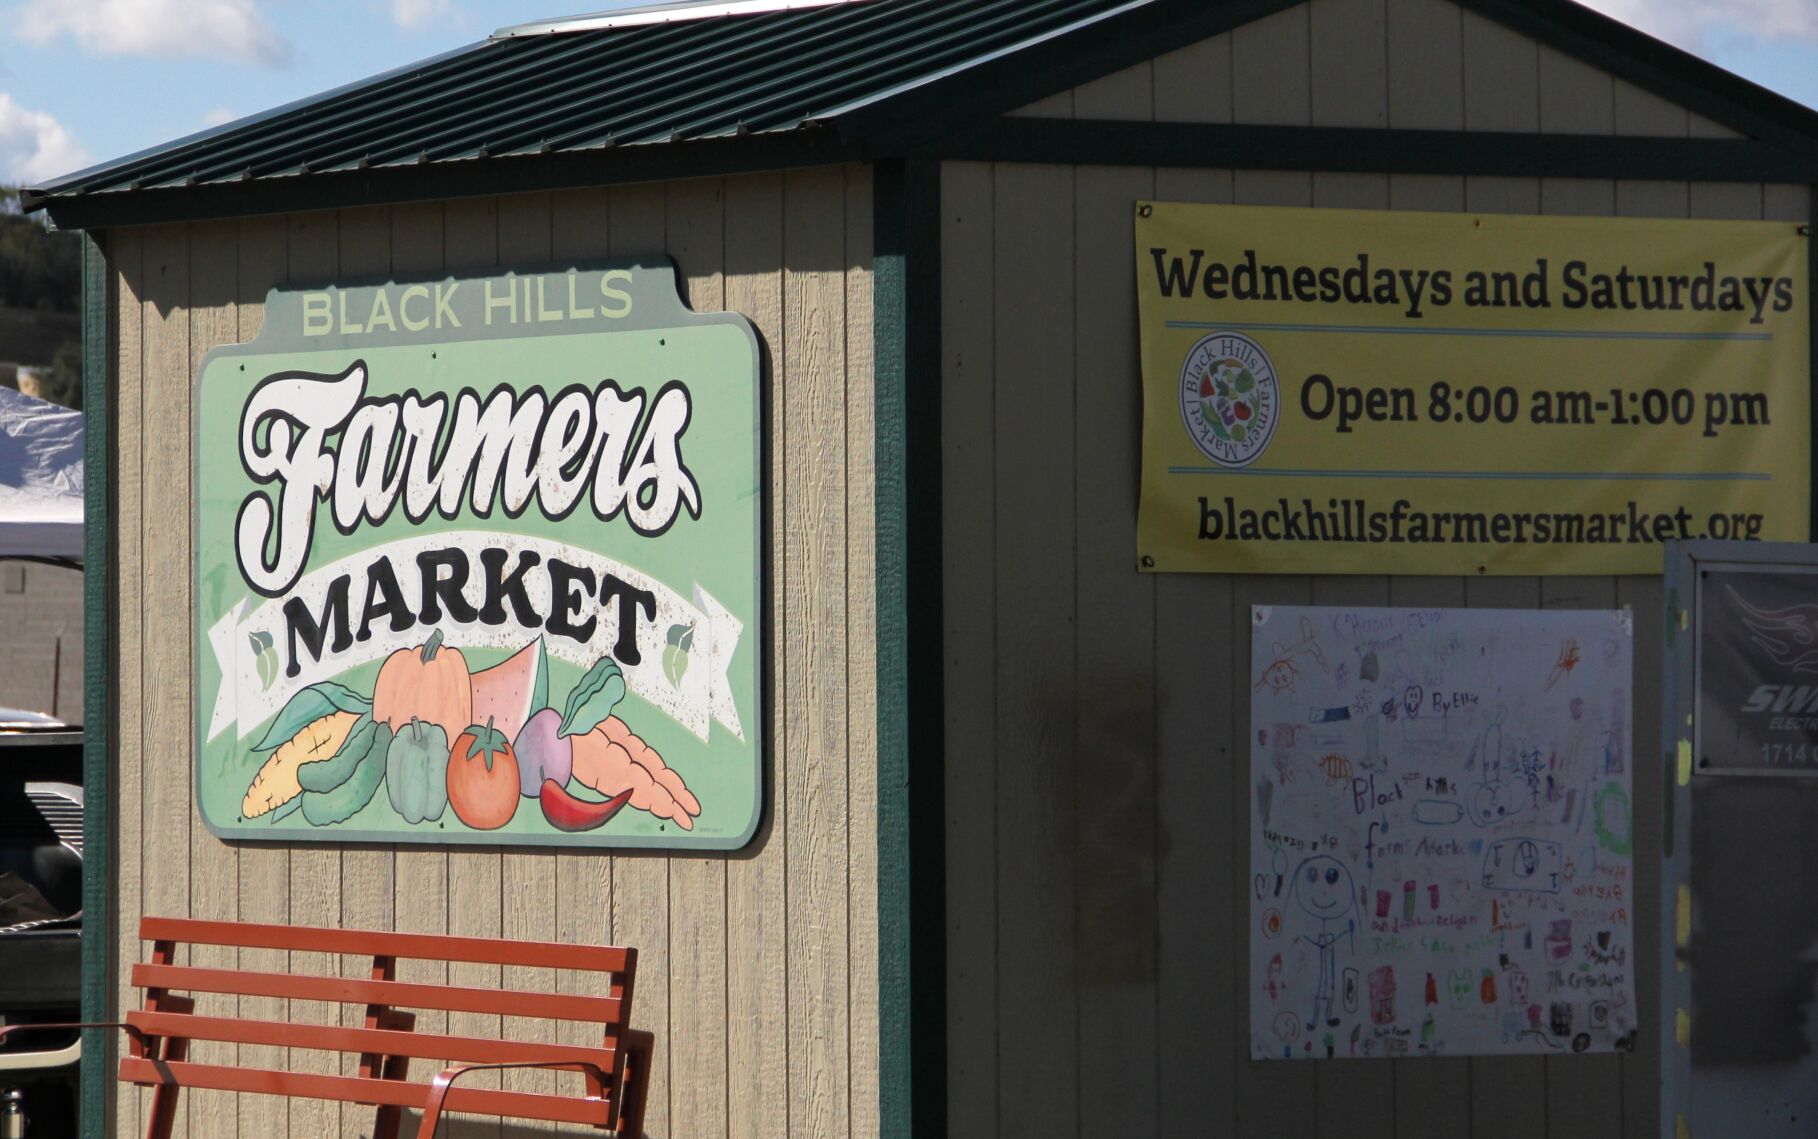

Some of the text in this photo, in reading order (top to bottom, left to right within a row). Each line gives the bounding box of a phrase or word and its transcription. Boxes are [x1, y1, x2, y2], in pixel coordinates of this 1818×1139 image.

[302, 269, 634, 337] BLACK HILLS
[1150, 248, 1793, 323] Wednesdays and Saturdays
[1186, 339, 1271, 460] Black Hills Farmers Market
[1301, 374, 1771, 437] Open 8:00 am-1:00 pm
[235, 359, 703, 598] Farmers
[1198, 497, 1764, 543] blackhillsfarmersmarket.org
[284, 547, 657, 678] MARKET
[1432, 692, 1480, 717] By Ellie
[1761, 744, 1807, 763] 1714
